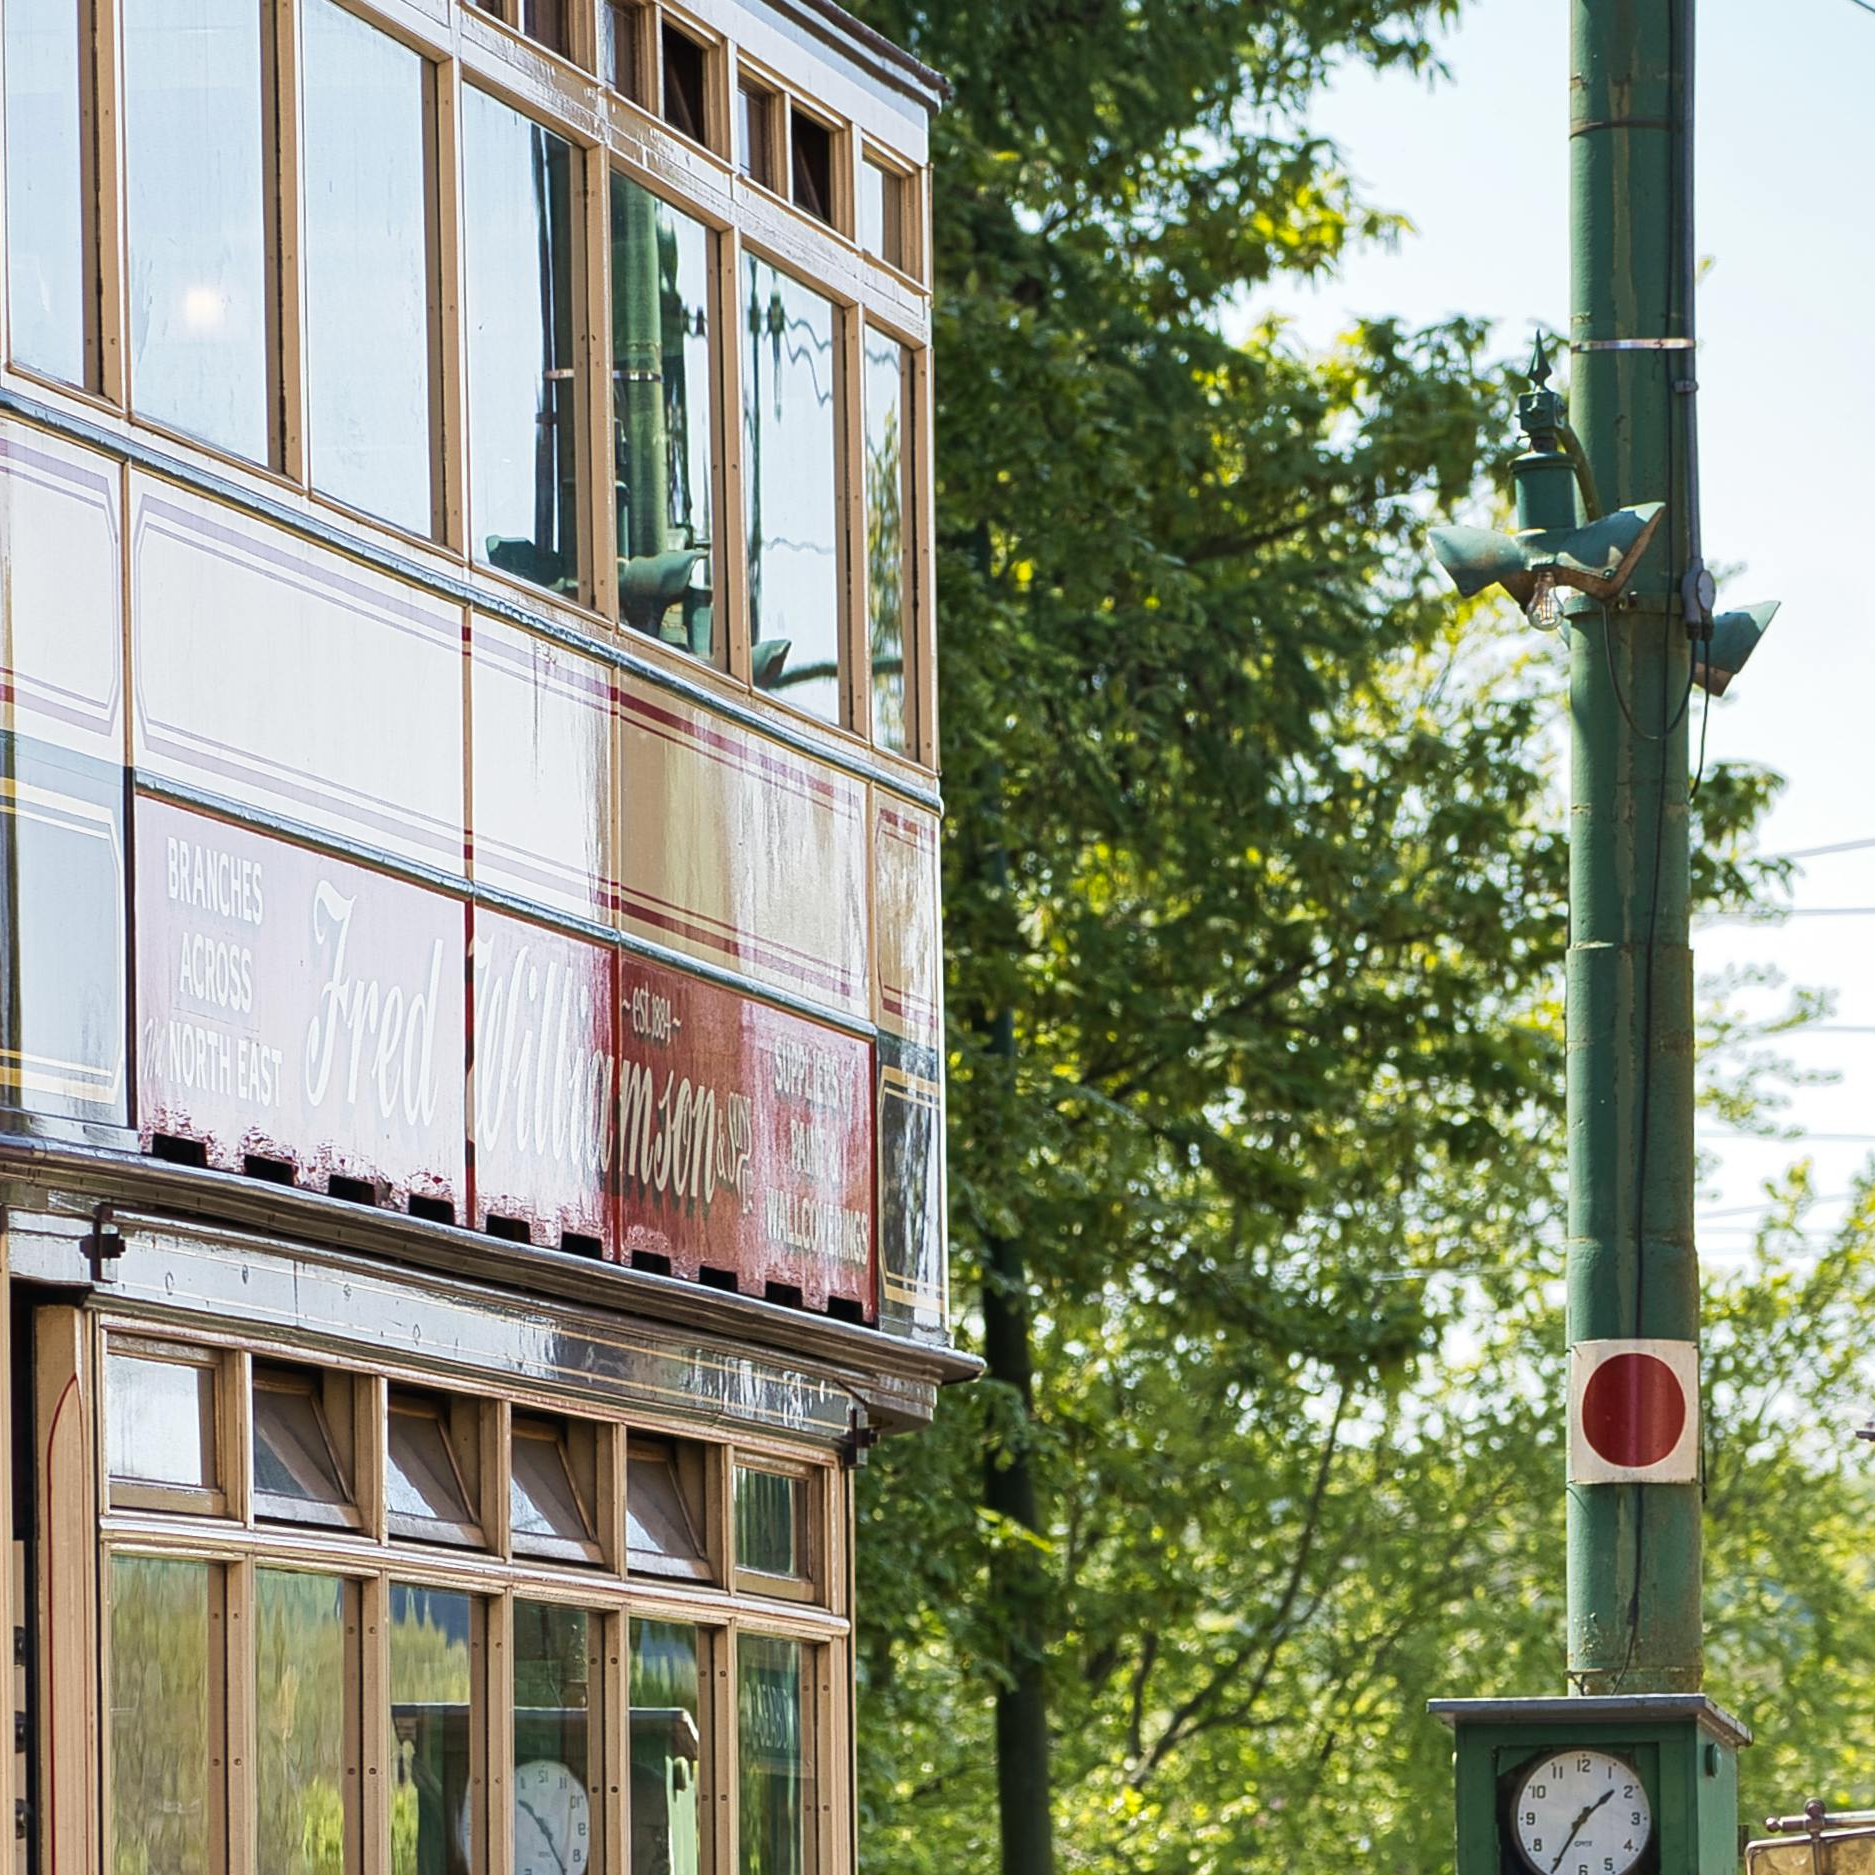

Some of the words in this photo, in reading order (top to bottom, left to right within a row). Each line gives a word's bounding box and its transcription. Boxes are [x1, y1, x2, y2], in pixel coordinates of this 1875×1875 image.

[167, 836, 263, 926] BRANCHES
[180, 931, 253, 1013] ACROSS
[305, 879, 444, 1127] Fred
[465, 928, 717, 1203] Williamson
[169, 1019, 231, 1096] NORTH
[237, 1038, 283, 1108] EAST
[775, 1036, 840, 1109] SUPPLIERS
[765, 1185, 869, 1266] WALLCOVERINGS
[1553, 1766, 1563, 1780] 11
[1577, 1759, 1591, 1773] 12
[1531, 1785, 1546, 1799] 10
[1623, 1785, 1633, 1799] 2
[1526, 1812, 1536, 1825] 9
[1631, 1812, 1641, 1826] 3
[1533, 1838, 1542, 1852] 8
[1623, 1838, 1633, 1852] 4
[1604, 1858, 1613, 1871] 5
